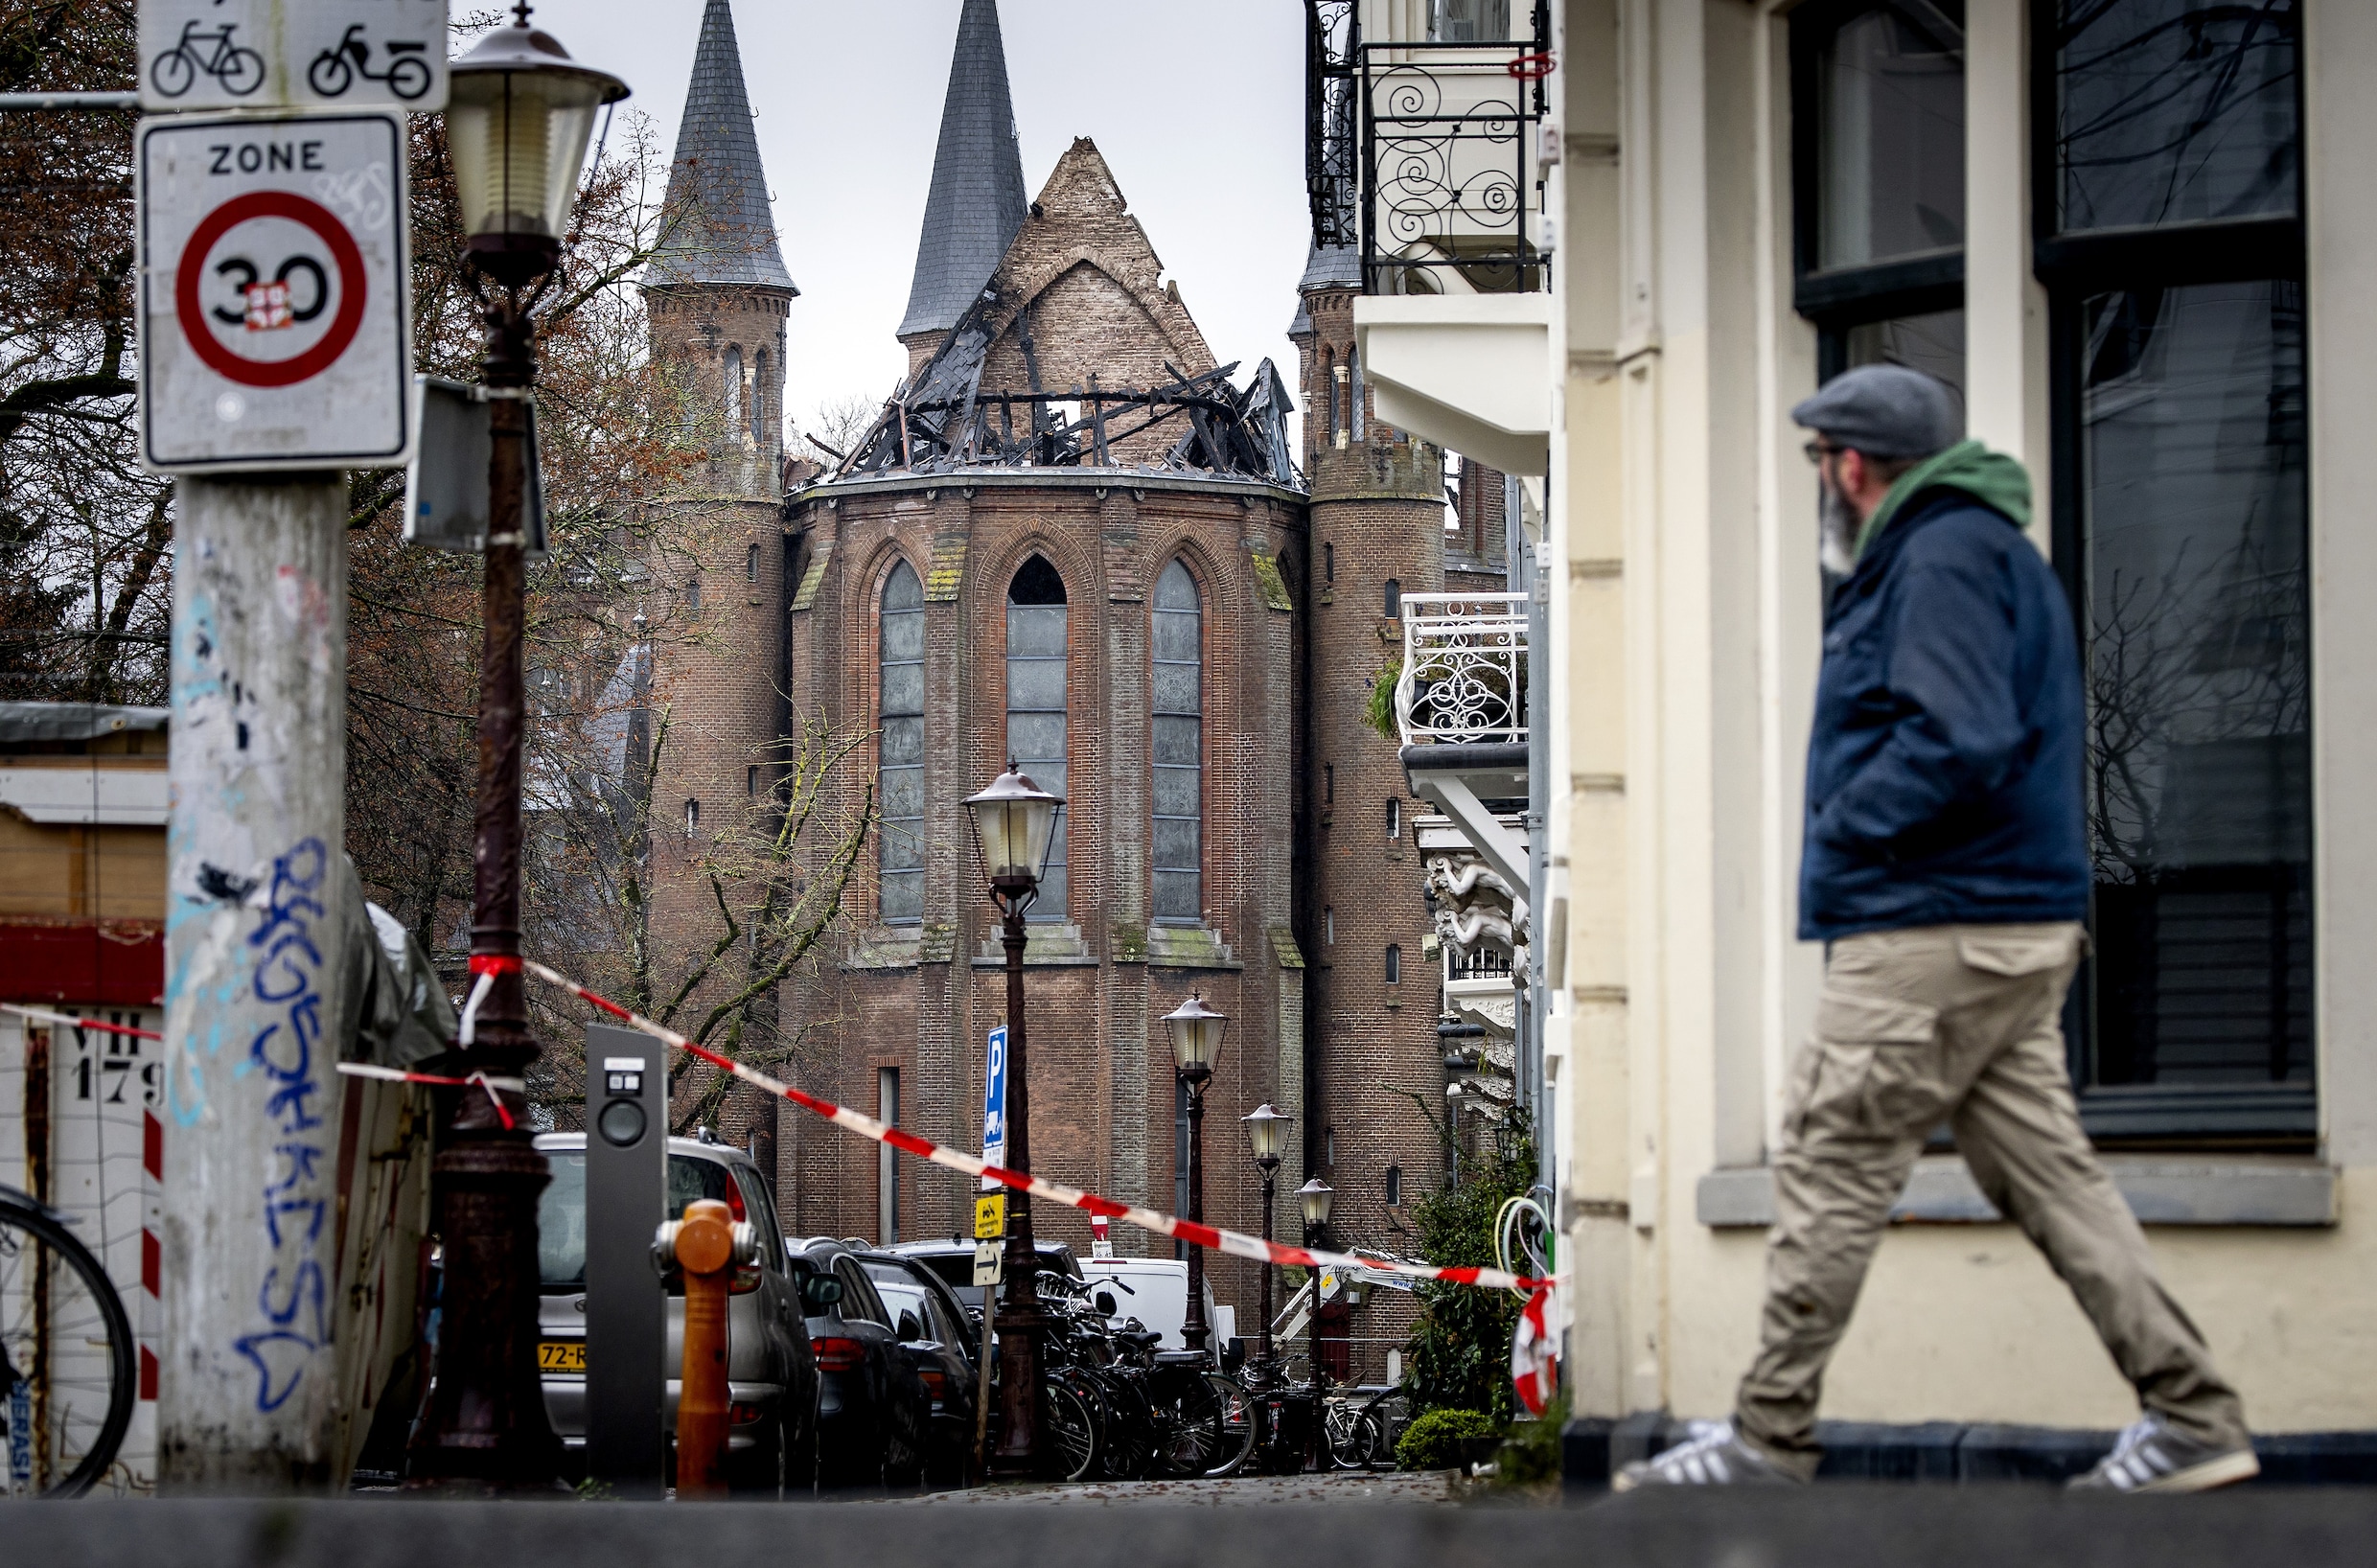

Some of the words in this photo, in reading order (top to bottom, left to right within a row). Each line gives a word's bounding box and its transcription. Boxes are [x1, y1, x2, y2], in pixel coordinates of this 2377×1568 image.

[209, 141, 325, 175] ZONE
[212, 254, 328, 325] 30
[70, 1055, 166, 1109] 179
[989, 1040, 1003, 1099] P
[542, 1346, 588, 1366] 72-R
